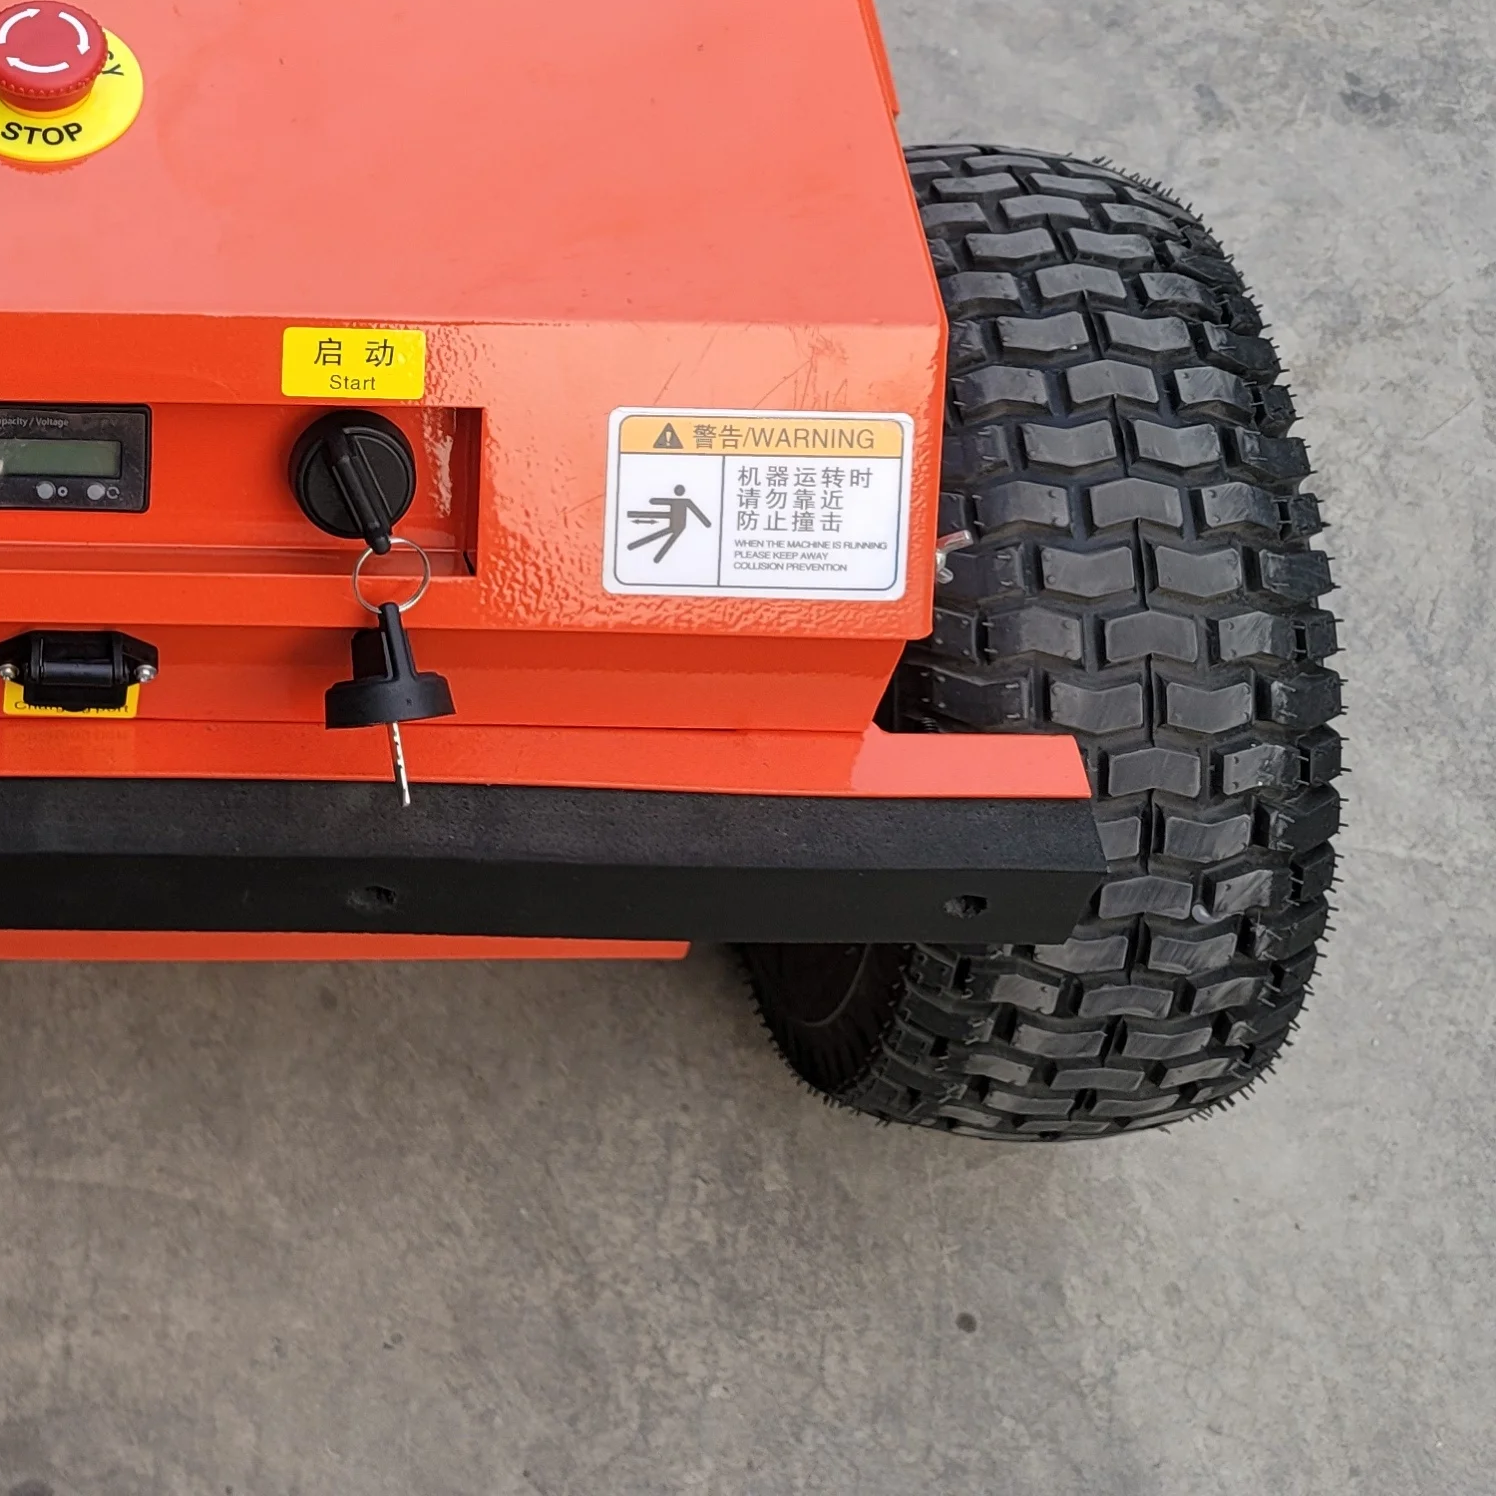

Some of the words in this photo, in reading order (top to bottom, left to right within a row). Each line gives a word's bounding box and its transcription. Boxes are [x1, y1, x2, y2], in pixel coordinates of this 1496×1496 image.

[0, 122, 83, 146] STOP
[314, 337, 394, 368] 启动
[329, 374, 376, 391] Start
[36, 417, 69, 428] Voltage
[692, 424, 875, 450] 警告/WARNING
[737, 466, 874, 489] 机器运转时
[736, 488, 844, 511] 请勿靠近
[736, 510, 843, 533] 防止撞击
[734, 539, 764, 548] WHEN
[766, 540, 786, 548] THE
[787, 540, 831, 549] MACHINE
[832, 540, 842, 550] IS
[843, 541, 888, 550] RUNNING
[734, 550, 771, 559] PLEASE
[773, 552, 798, 560] KEEP
[800, 552, 828, 560] AWAY
[734, 562, 784, 570] COLLISION
[786, 562, 848, 572] PREVENTION
